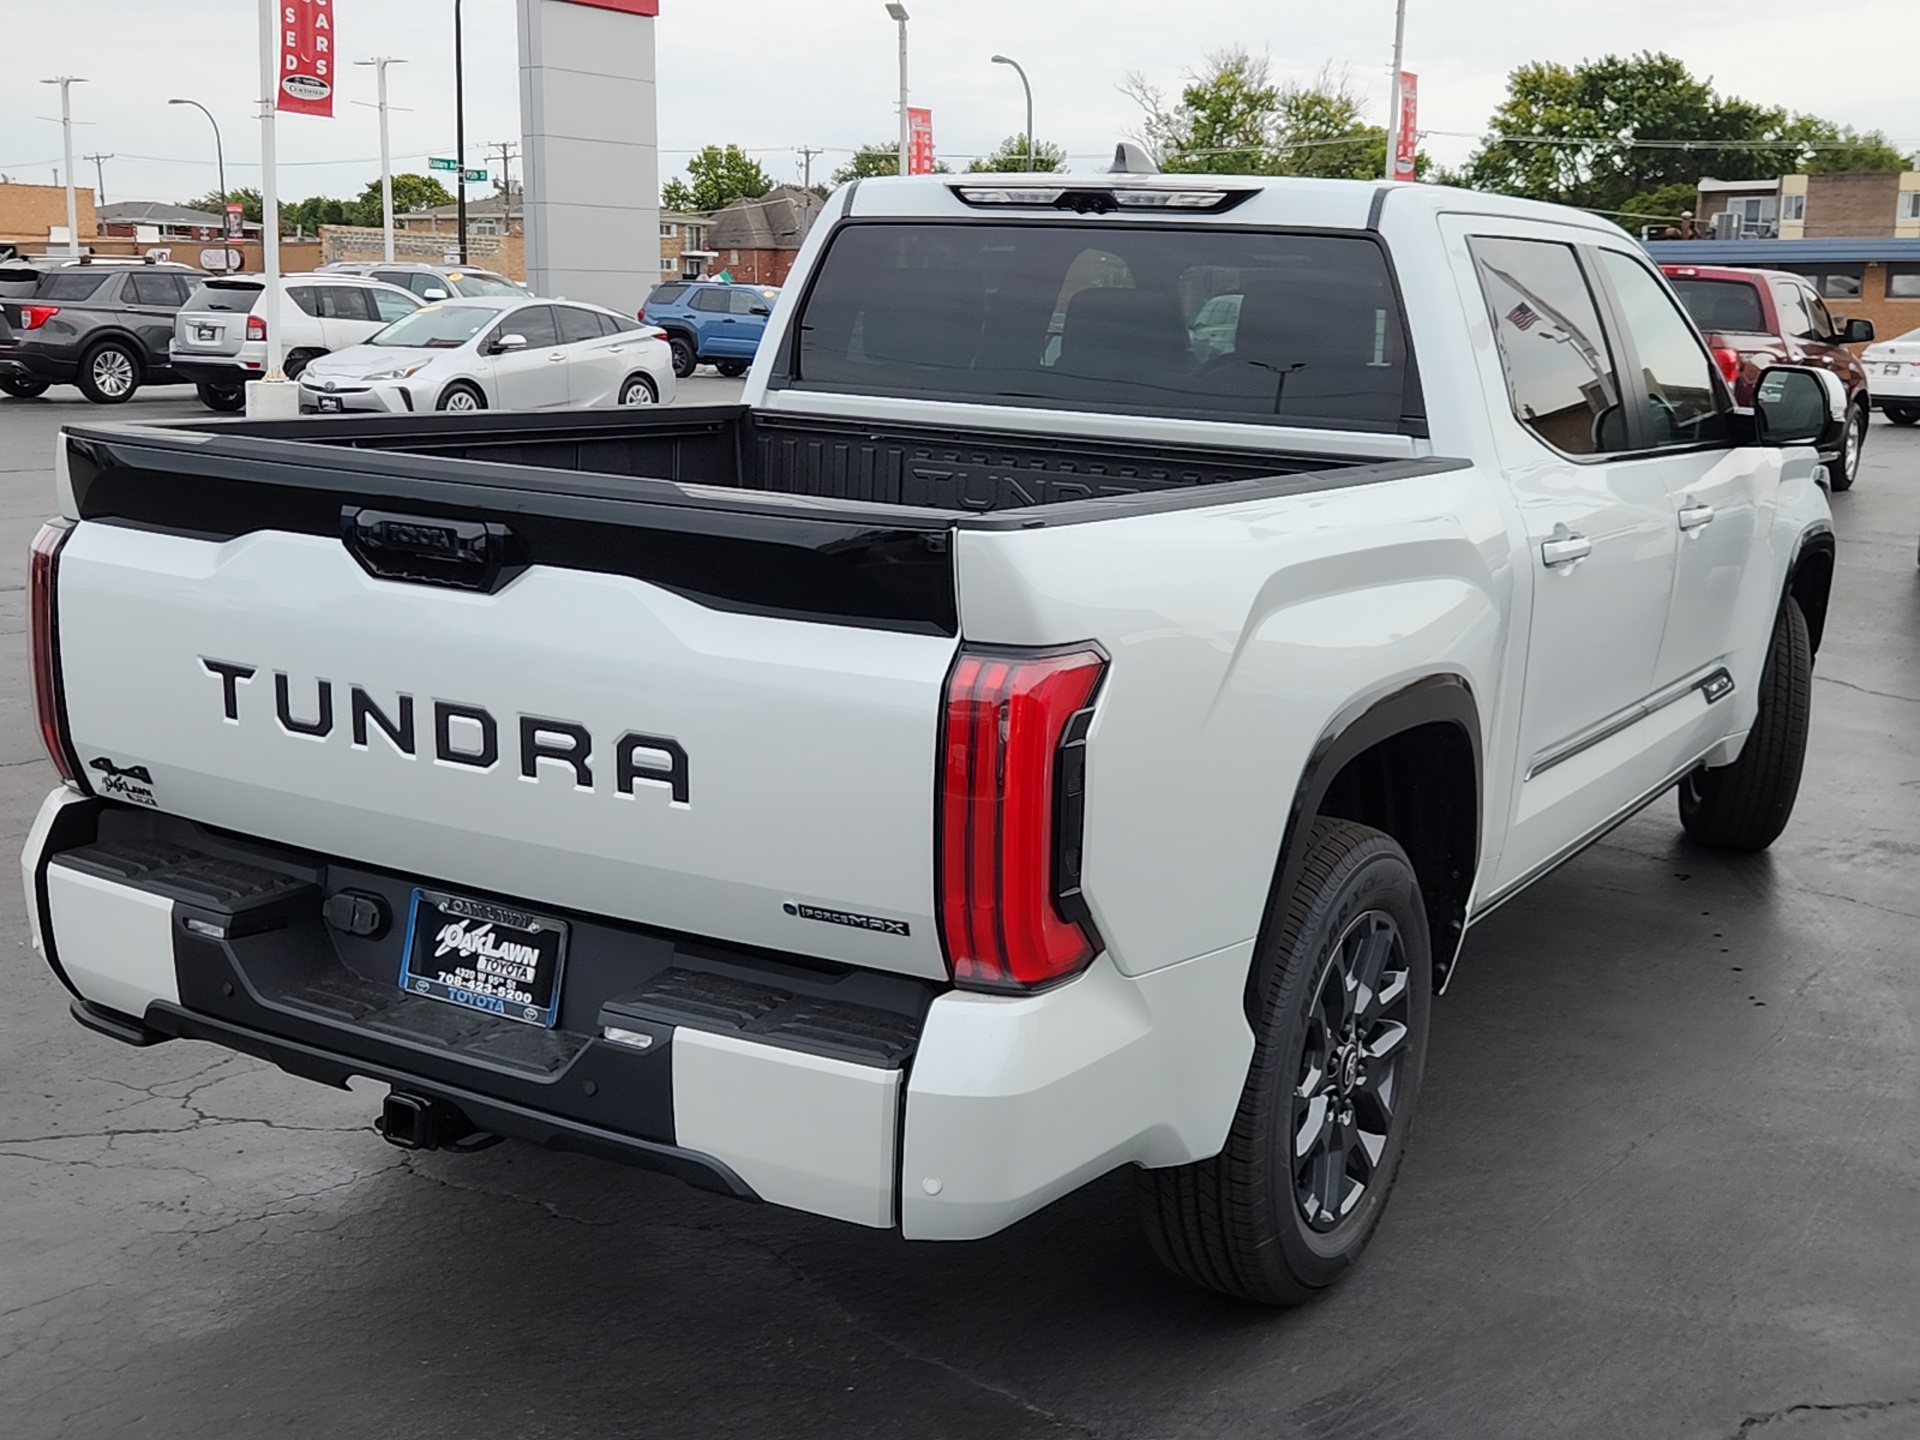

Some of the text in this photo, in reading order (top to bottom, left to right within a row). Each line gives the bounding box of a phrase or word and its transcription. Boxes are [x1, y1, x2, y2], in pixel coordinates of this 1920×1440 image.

[389, 525, 450, 548] TOYOTA
[200, 656, 691, 806] TUNDRA
[484, 958, 530, 981] TOYOTA
[438, 972, 533, 1004] 708-423-5200
[448, 988, 505, 1014] TOYOTA
